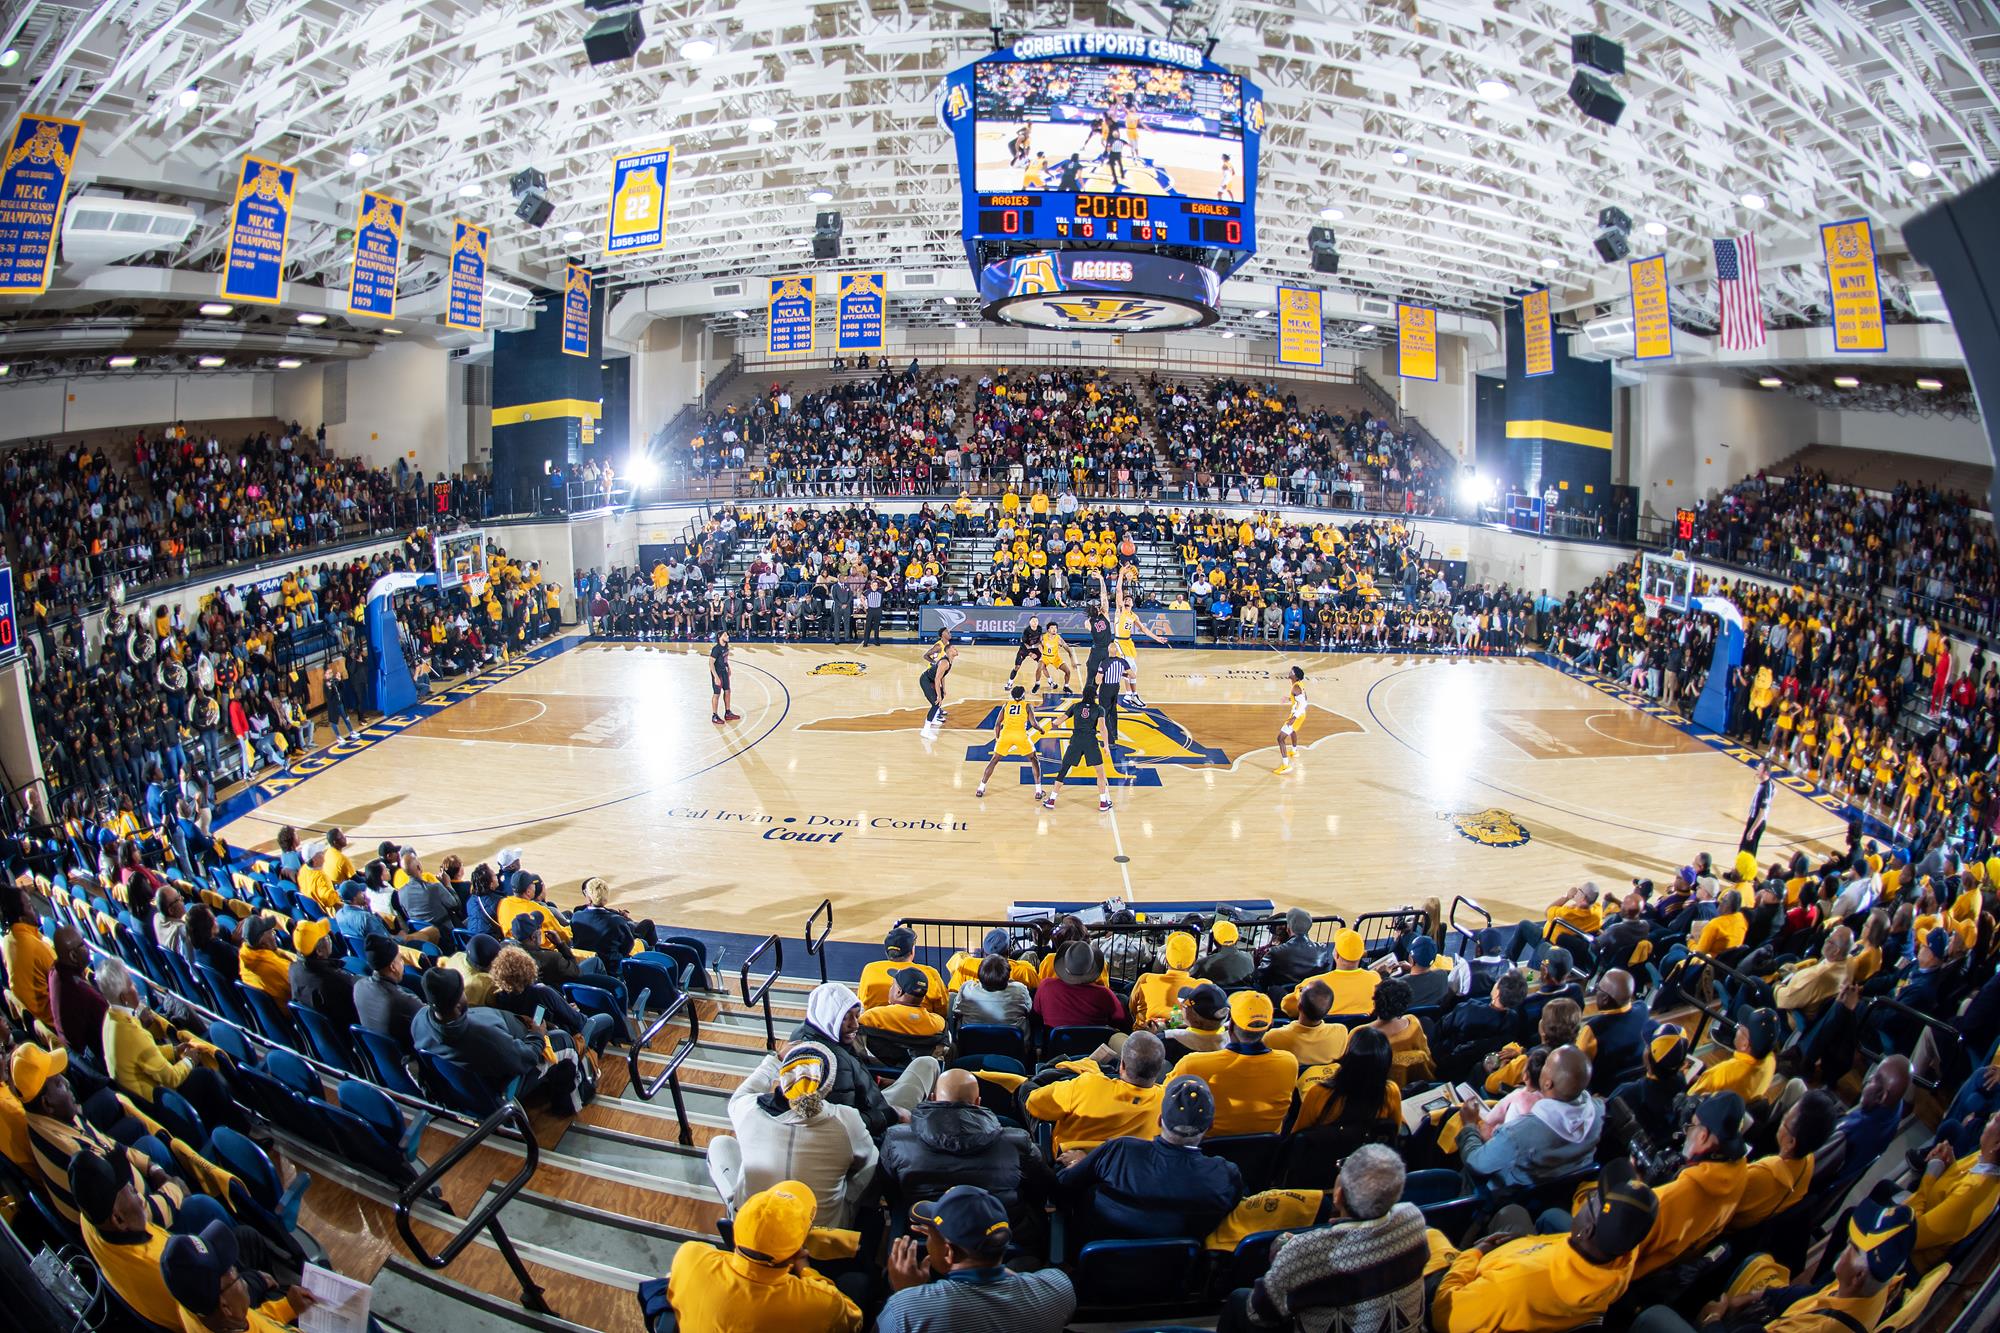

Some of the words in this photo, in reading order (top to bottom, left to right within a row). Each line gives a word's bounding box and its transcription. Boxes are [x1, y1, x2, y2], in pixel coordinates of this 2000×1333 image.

[1013, 34, 1082, 60] CORBETT
[1084, 33, 1146, 56] SPORTS
[1148, 38, 1204, 68] CENTER
[619, 158, 640, 170] ALVIN
[640, 154, 667, 166] ATTLES
[14, 184, 48, 200] MEAC
[624, 194, 651, 221] 22
[992, 196, 1030, 206] AGGIES
[1076, 195, 1148, 220] 20:00
[1191, 203, 1229, 216] EAGLES
[248, 214, 275, 230] MEAC
[1003, 210, 1018, 234] 0
[1112, 220, 1118, 233] 1
[1058, 224, 1068, 236] 4
[1083, 224, 1093, 237] 0
[1142, 226, 1152, 240] 0
[1156, 227, 1166, 240] 4
[1226, 220, 1241, 244] 0
[235, 233, 282, 251] CHAMPIONS
[366, 240, 390, 254] MEAC
[357, 258, 395, 274] CHAMPIONS
[460, 264, 478, 276] MEAC
[1072, 261, 1133, 281] AGGIES
[356, 283, 373, 294] 1976
[1839, 274, 1866, 288] WNIT
[778, 308, 805, 318] NCAA
[848, 304, 875, 314] NCAA
[1287, 319, 1312, 329] MEAC
[436, 494, 449, 512] 30
[1679, 520, 1693, 540] 30
[0, 618, 12, 644] 0
[976, 620, 1016, 632] EAGLES
[1095, 620, 1108, 632] 13
[1010, 704, 1020, 714] 21
[1081, 707, 1090, 718] 5
[259, 714, 424, 797] AGGIE
[421, 656, 547, 708] PRIDE
[1569, 672, 1693, 727] AGGIE
[1695, 734, 1849, 812] PRIDE
[668, 806, 708, 819] Cal
[715, 810, 774, 823] Irvin
[807, 815, 860, 827] Don
[870, 816, 969, 832] Corbett
[762, 827, 844, 844] Court
